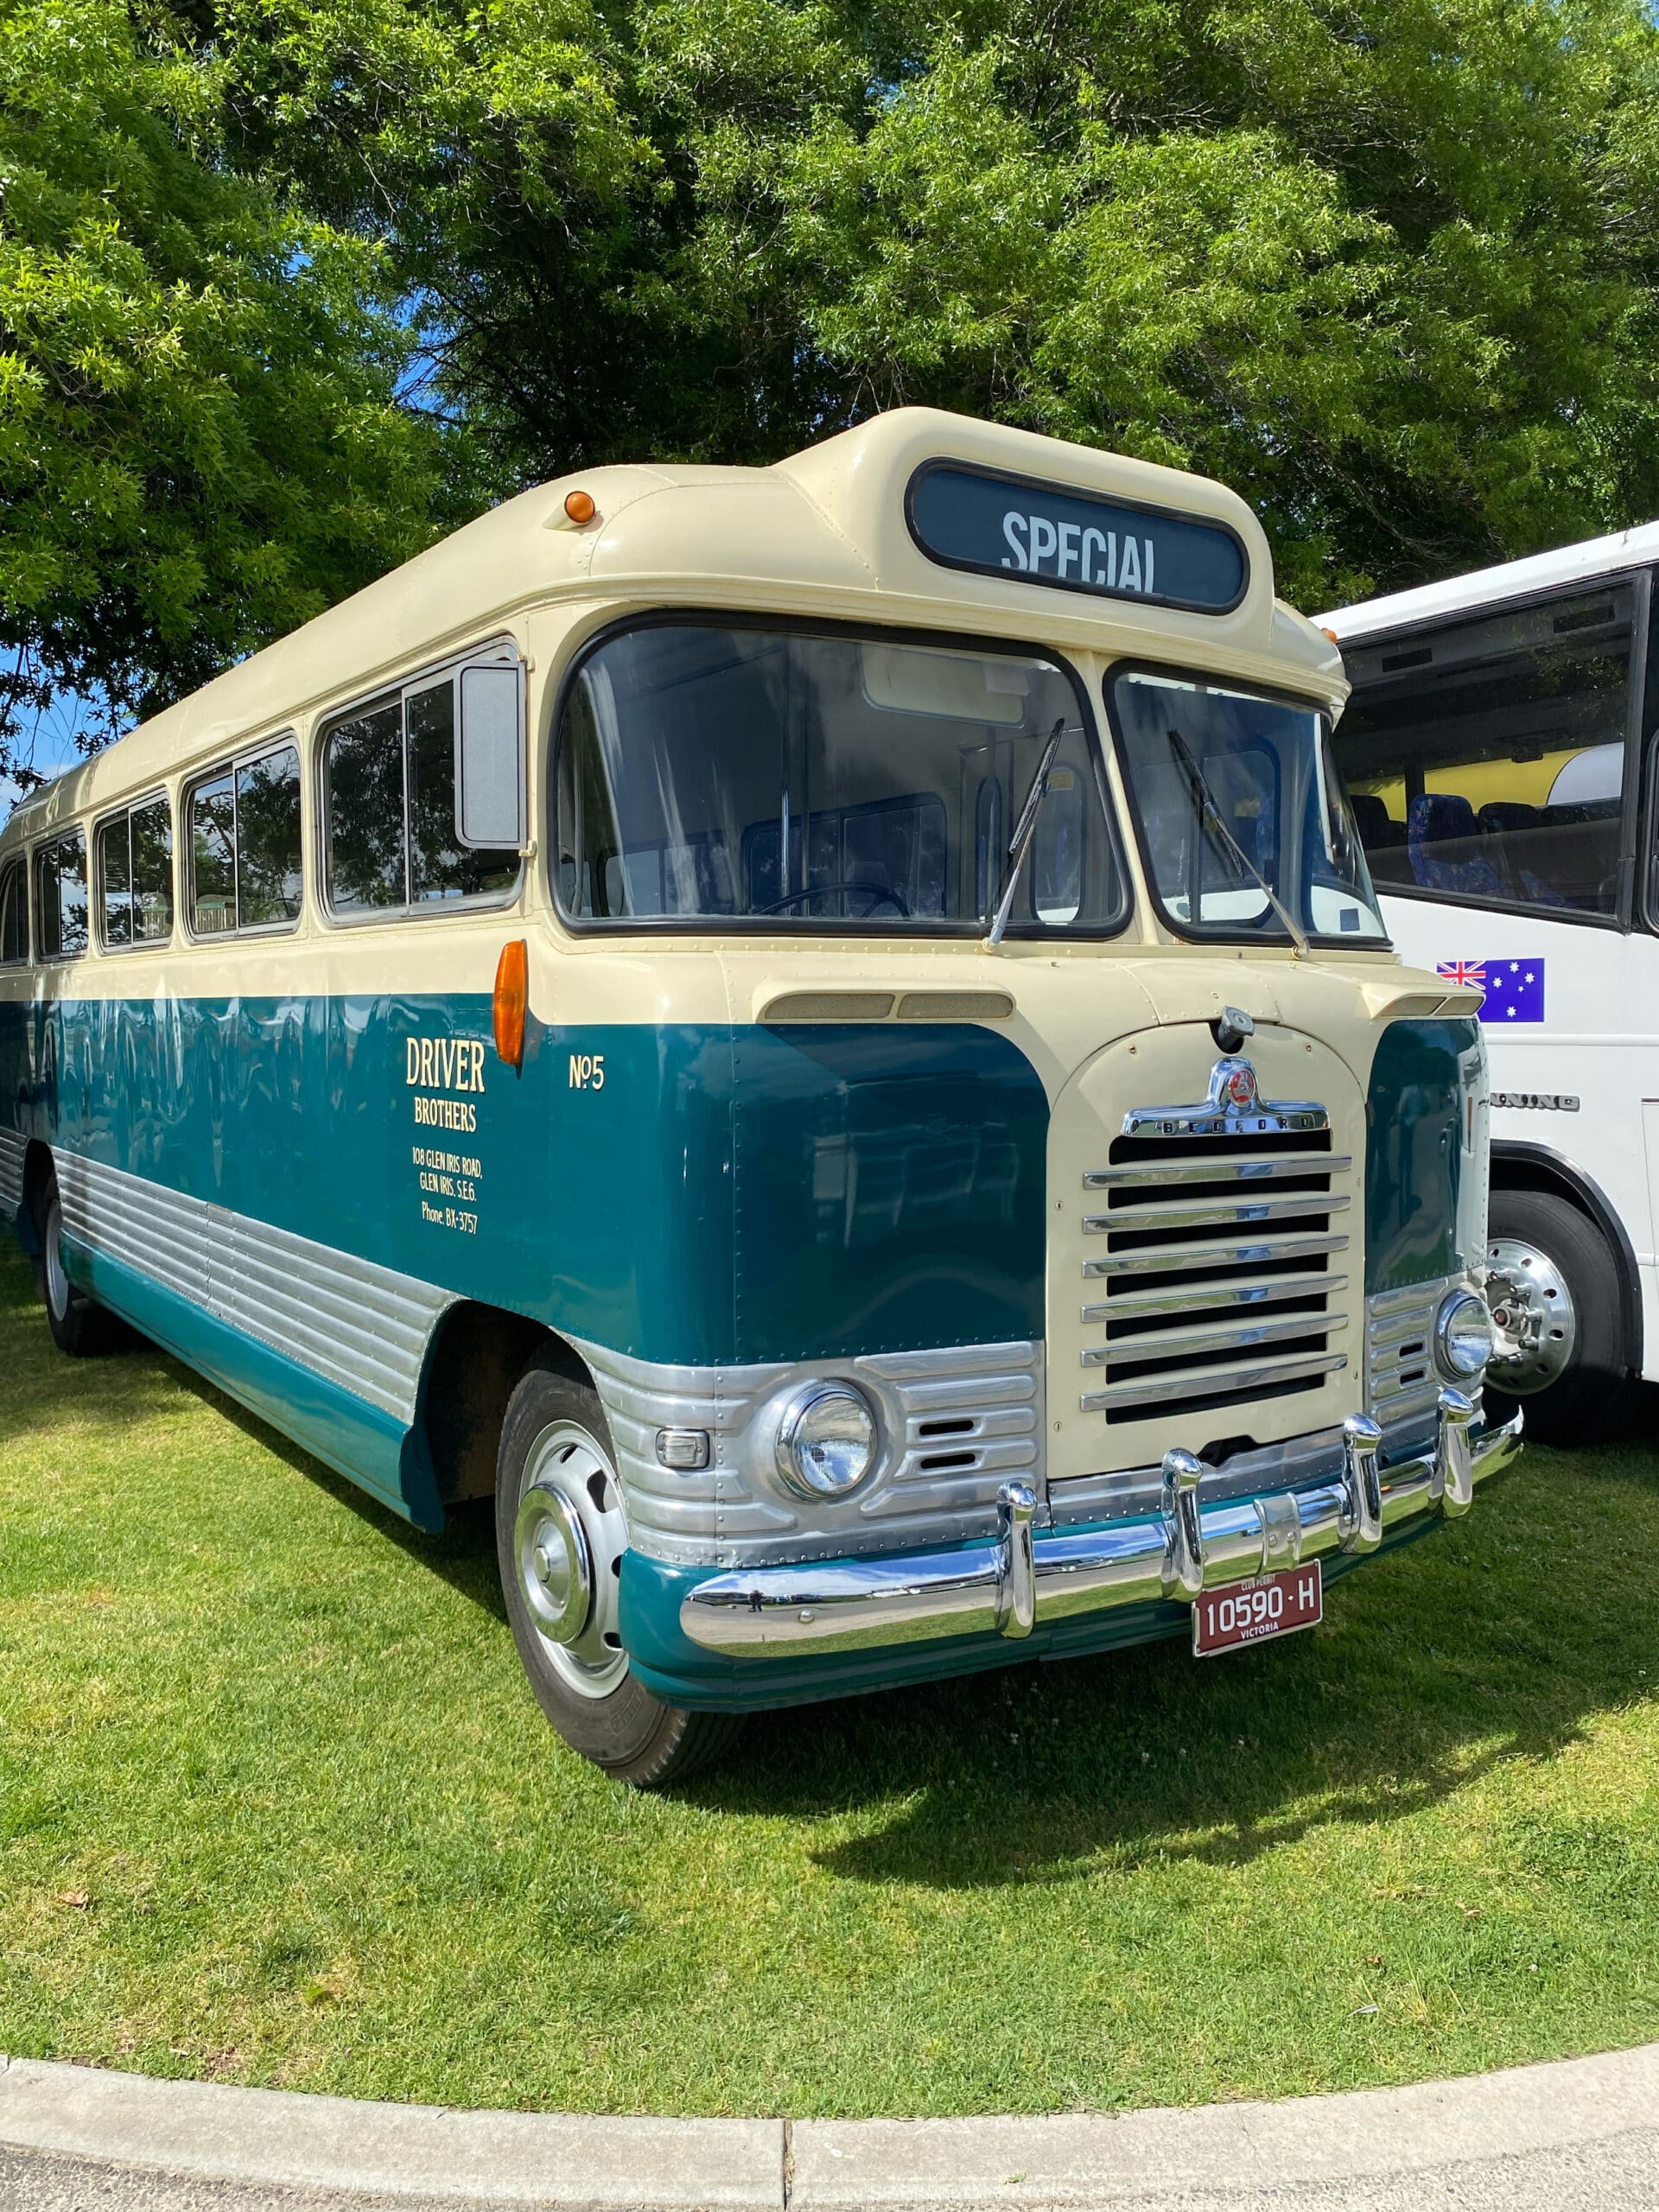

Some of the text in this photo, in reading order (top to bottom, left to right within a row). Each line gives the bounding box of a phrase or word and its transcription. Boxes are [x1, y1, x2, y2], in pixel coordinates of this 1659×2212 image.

[1001, 512, 1162, 594] SPECIAL
[406, 1037, 486, 1093] DRIVER
[414, 1096, 477, 1133] BROTHERS
[1162, 1117, 1311, 1134] BEDFORD
[412, 1147, 425, 1166] 108
[426, 1149, 446, 1171] GLEN
[446, 1153, 461, 1173] IRIS
[420, 1172, 439, 1193] GLEN
[1240, 1621, 1280, 1640] VICTORIA
